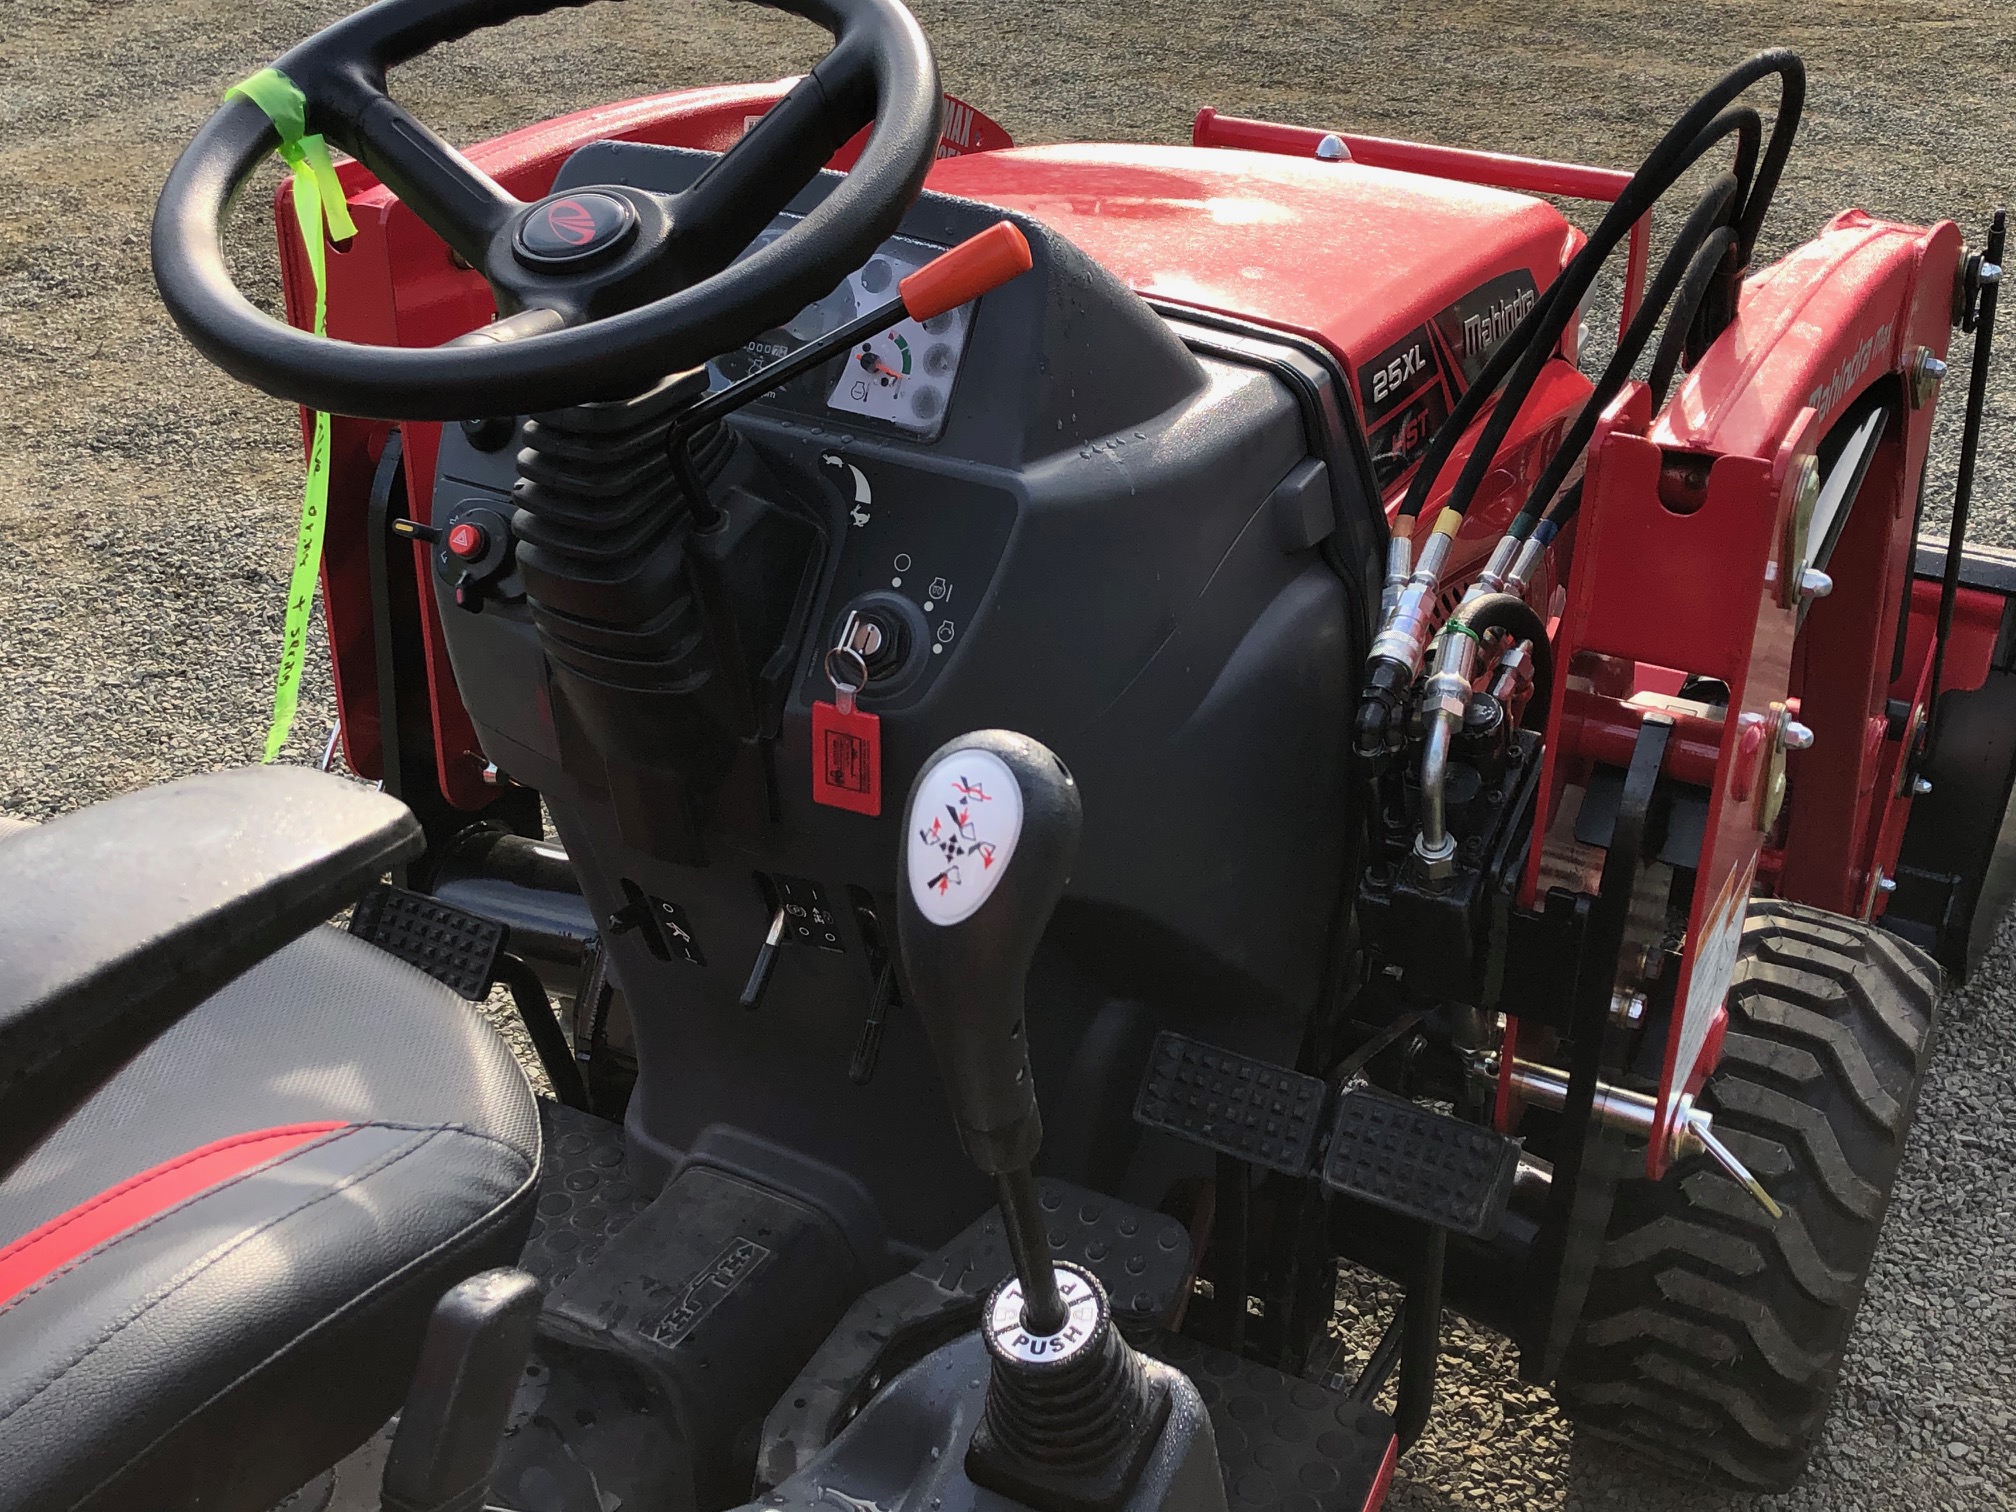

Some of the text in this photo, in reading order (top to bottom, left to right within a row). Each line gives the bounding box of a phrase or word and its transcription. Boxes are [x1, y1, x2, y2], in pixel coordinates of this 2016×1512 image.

[1463, 288, 1535, 358] Mahindra
[1372, 344, 1426, 404] 25XL
[1808, 336, 1874, 424] Mahindra
[1391, 408, 1430, 461] HST
[1010, 1325, 1083, 1355] PUSH
